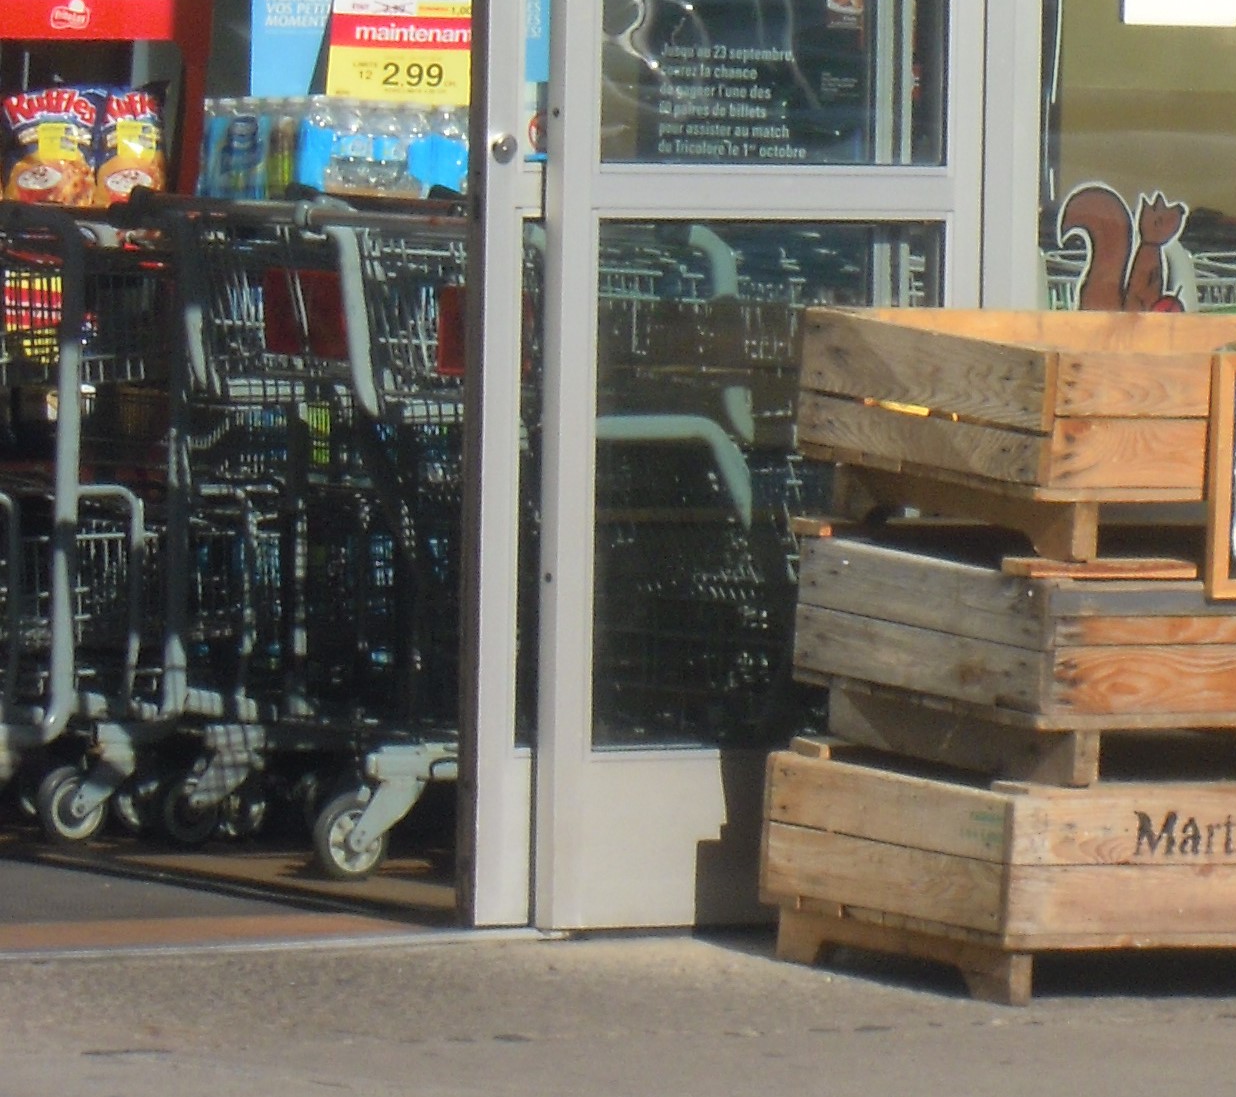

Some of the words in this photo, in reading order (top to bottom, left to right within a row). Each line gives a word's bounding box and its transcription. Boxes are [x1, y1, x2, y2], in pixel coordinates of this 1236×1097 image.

[266, 3, 291, 15] VOS
[265, 16, 326, 28] MOMENT
[355, 22, 471, 44] maintenan
[713, 45, 727, 60] 23
[382, 62, 443, 87] 2.99
[714, 65, 758, 81] chance
[749, 86, 772, 100] des
[712, 104, 726, 117] de
[729, 103, 767, 119] billets
[734, 125, 749, 136] au
[752, 124, 790, 139] match
[759, 144, 808, 159] octobre
